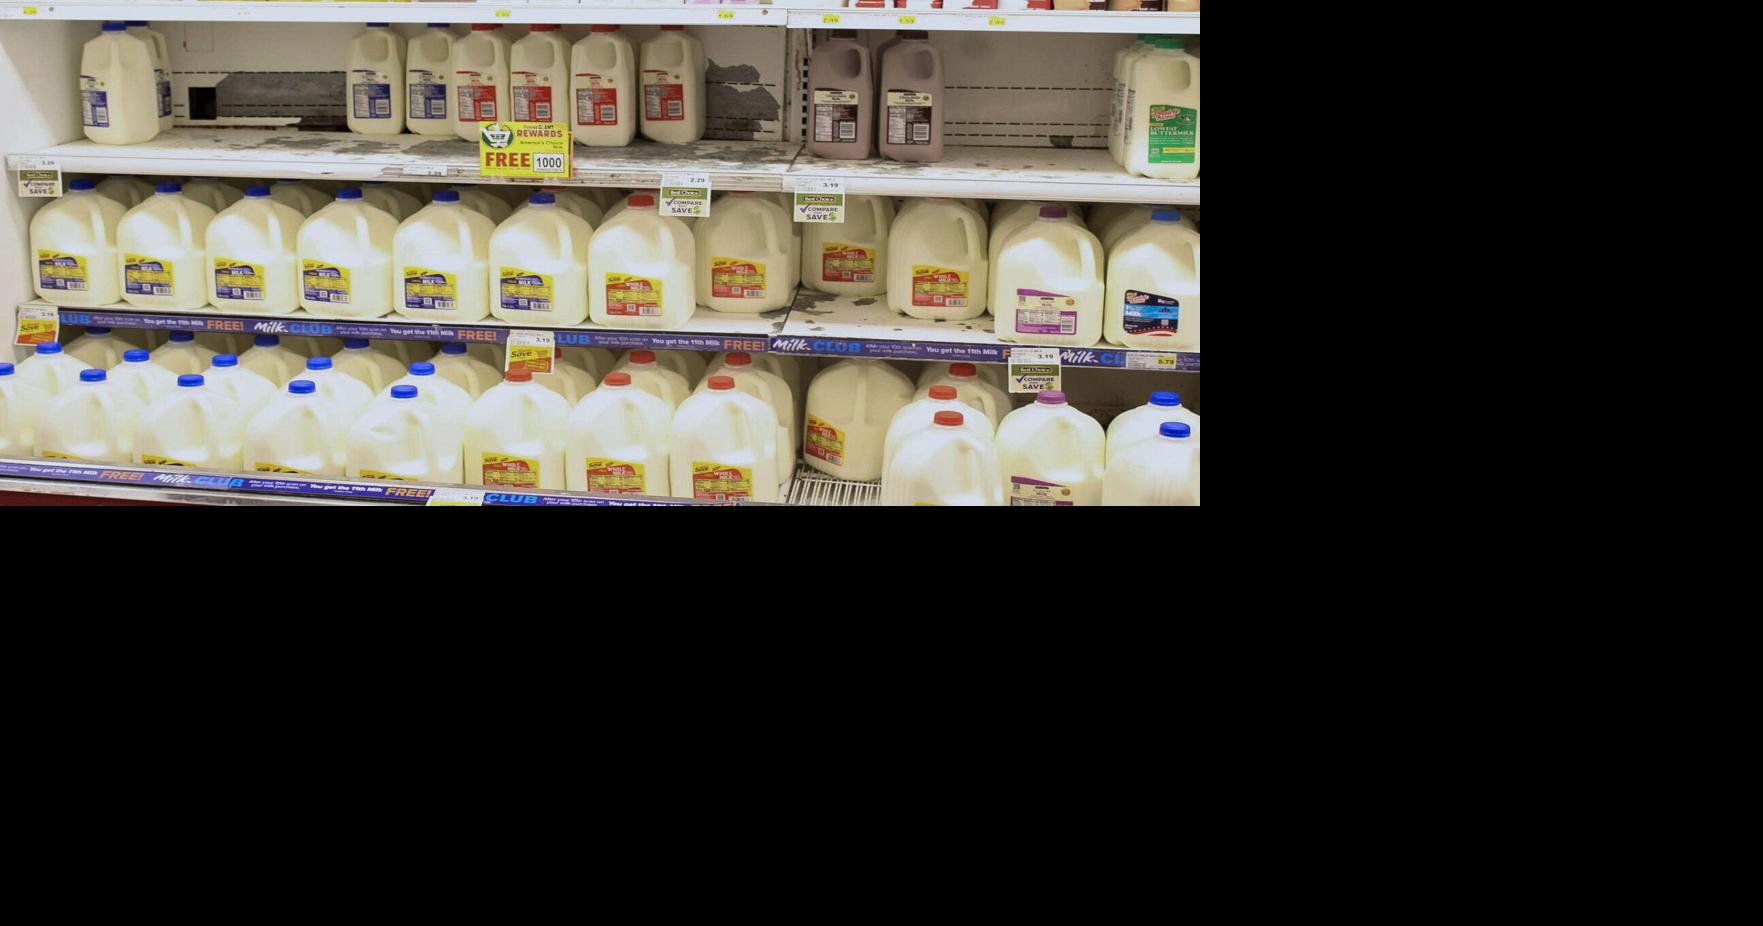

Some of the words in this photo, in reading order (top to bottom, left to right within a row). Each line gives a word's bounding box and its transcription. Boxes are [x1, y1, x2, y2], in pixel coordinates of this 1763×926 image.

[516, 130, 563, 138] REWARDS
[486, 152, 530, 167] FREE
[536, 158, 562, 168] 1000
[60, 312, 92, 325] LUB
[206, 320, 244, 331] FREE!
[289, 322, 334, 334] CLUB
[458, 330, 496, 340] FREE!
[557, 333, 591, 344] LUB
[724, 339, 765, 351] FREE!
[813, 340, 860, 352] CLUB
[1100, 353, 1120, 364] CL
[100, 471, 144, 480] FREE!
[194, 476, 244, 487] CLUB
[385, 487, 431, 498] FREE!
[486, 493, 538, 503] CLUB
